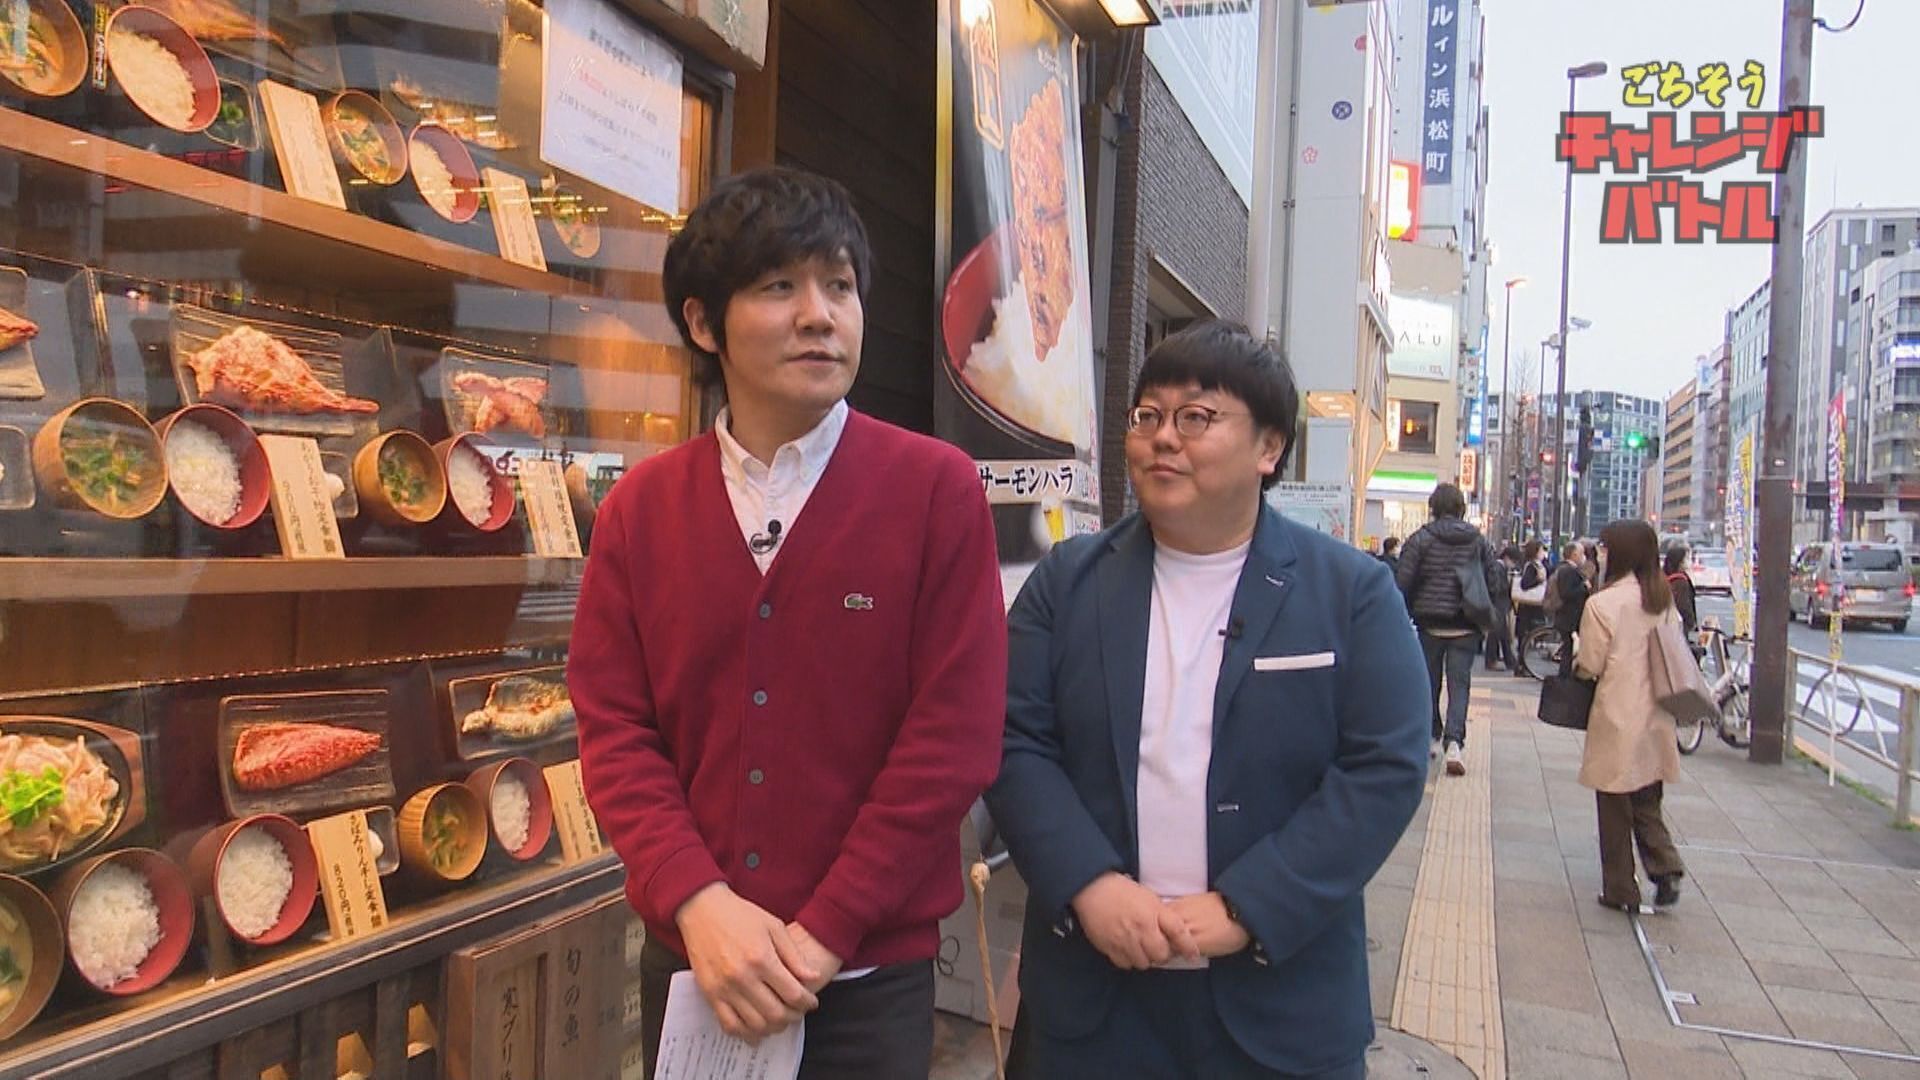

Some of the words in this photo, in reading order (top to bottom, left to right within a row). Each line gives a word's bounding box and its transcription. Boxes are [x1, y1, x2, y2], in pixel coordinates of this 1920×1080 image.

[1426, 4, 1453, 173] ルイン浜松町
[562, 948, 581, 1047] 旬の魚
